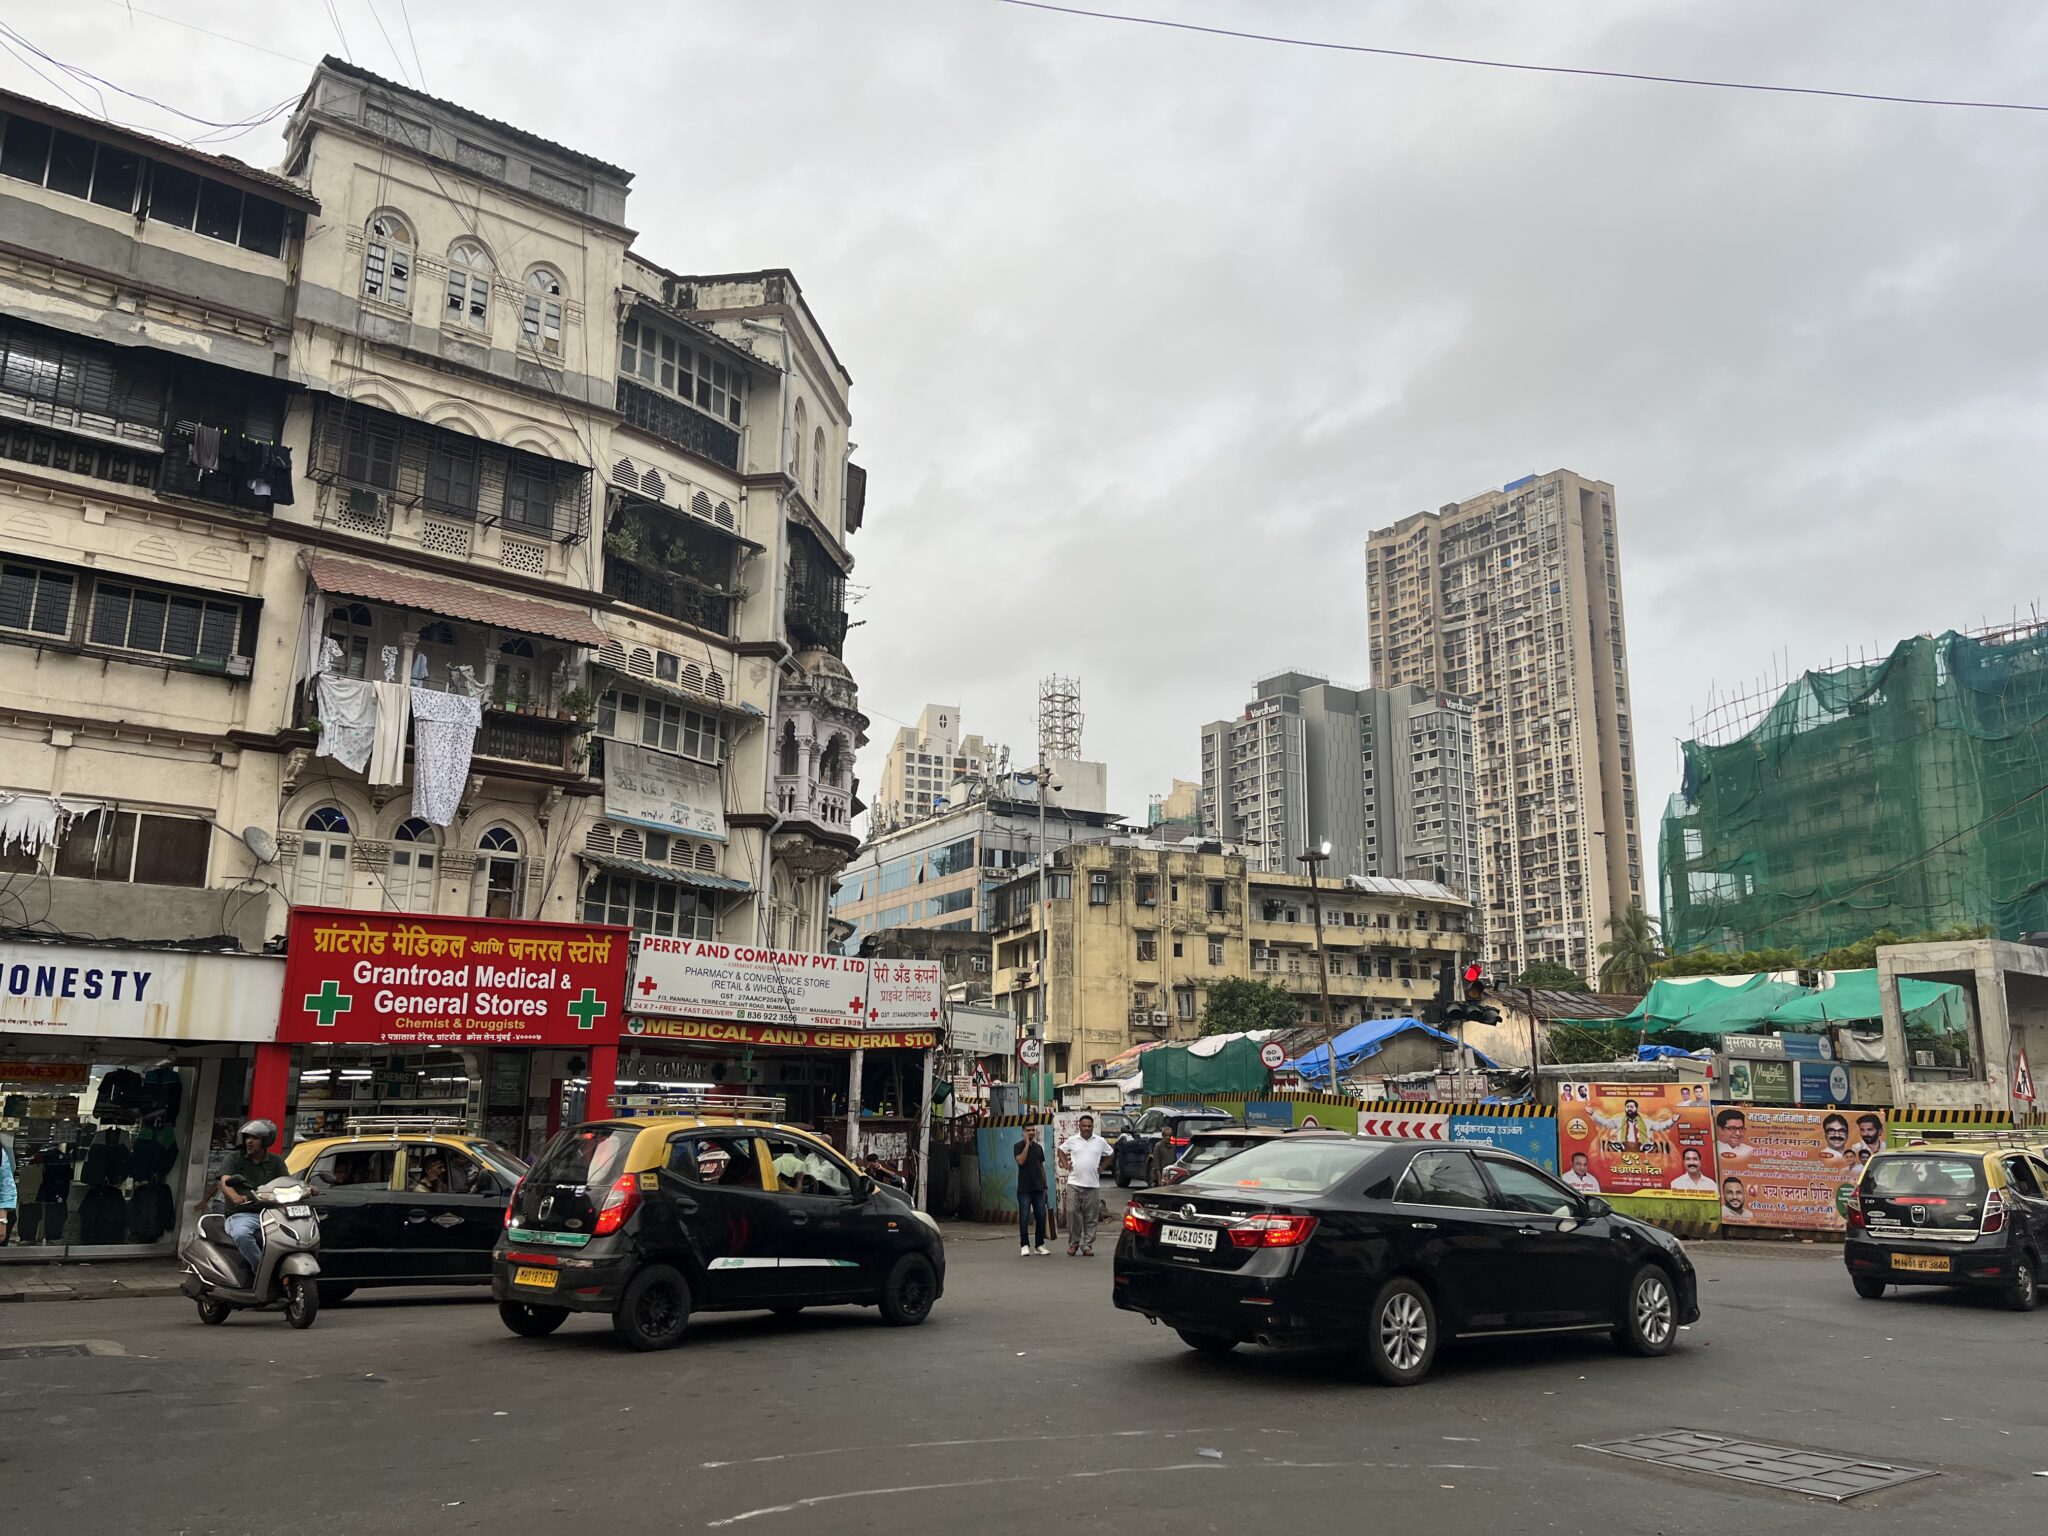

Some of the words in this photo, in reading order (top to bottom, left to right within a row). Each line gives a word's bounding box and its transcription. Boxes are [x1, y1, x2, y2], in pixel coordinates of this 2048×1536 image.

[1250, 701, 1280, 718] Vardhan
[313, 922, 389, 955] ग्रांटरोड
[392, 923, 467, 958] मेडिकल
[471, 938, 504, 954] आणि
[508, 938, 564, 962] जनरल
[568, 934, 612, 964] स्टोर्स
[643, 937, 693, 957] PERRY
[696, 944, 732, 960] AND
[734, 948, 809, 969] COMPANY
[812, 956, 840, 972] PVT.
[843, 962, 868, 974] LTD.
[0, 963, 152, 1002] ONESTY
[353, 960, 469, 987] Grantroad
[475, 966, 556, 989] Medical
[560, 973, 572, 989] &
[685, 967, 733, 980] PHARMACY
[735, 973, 742, 981] &
[743, 974, 802, 987] CONVENIENCE
[804, 979, 831, 989] STORE
[874, 961, 889, 984] पेरी
[892, 963, 911, 984] अँड
[914, 964, 939, 984] कंपनी
[669, 996, 700, 1004] PANNALAL
[712, 980, 743, 991] (RETAIL
[745, 983, 751, 991] &
[753, 985, 806, 998] WHOLESALE)
[880, 986, 903, 1003] प्राइवेट
[905, 986, 932, 1003] लिमिटेड
[374, 989, 468, 1015] General
[475, 992, 548, 1016] Stores
[395, 1017, 449, 1029] Chemist
[453, 1018, 462, 1029] &
[466, 1018, 526, 1031] Druggists
[658, 1005, 677, 1013] FREE
[702, 1010, 733, 1018] DELIVERY
[747, 1012, 762, 1020] 836
[763, 1013, 778, 1021] 922
[779, 1014, 798, 1023] 3556
[814, 1016, 841, 1025] SINCE
[843, 1018, 863, 1027] 1939
[645, 1019, 754, 1041] MEDICAL
[759, 1028, 808, 1047] AND
[814, 1032, 901, 1048] GENERAL
[377, 1071, 417, 1081] CHEMIST
[655, 1061, 709, 1080] COMPANY
[1167, 1228, 1213, 1246] MH46X0516
